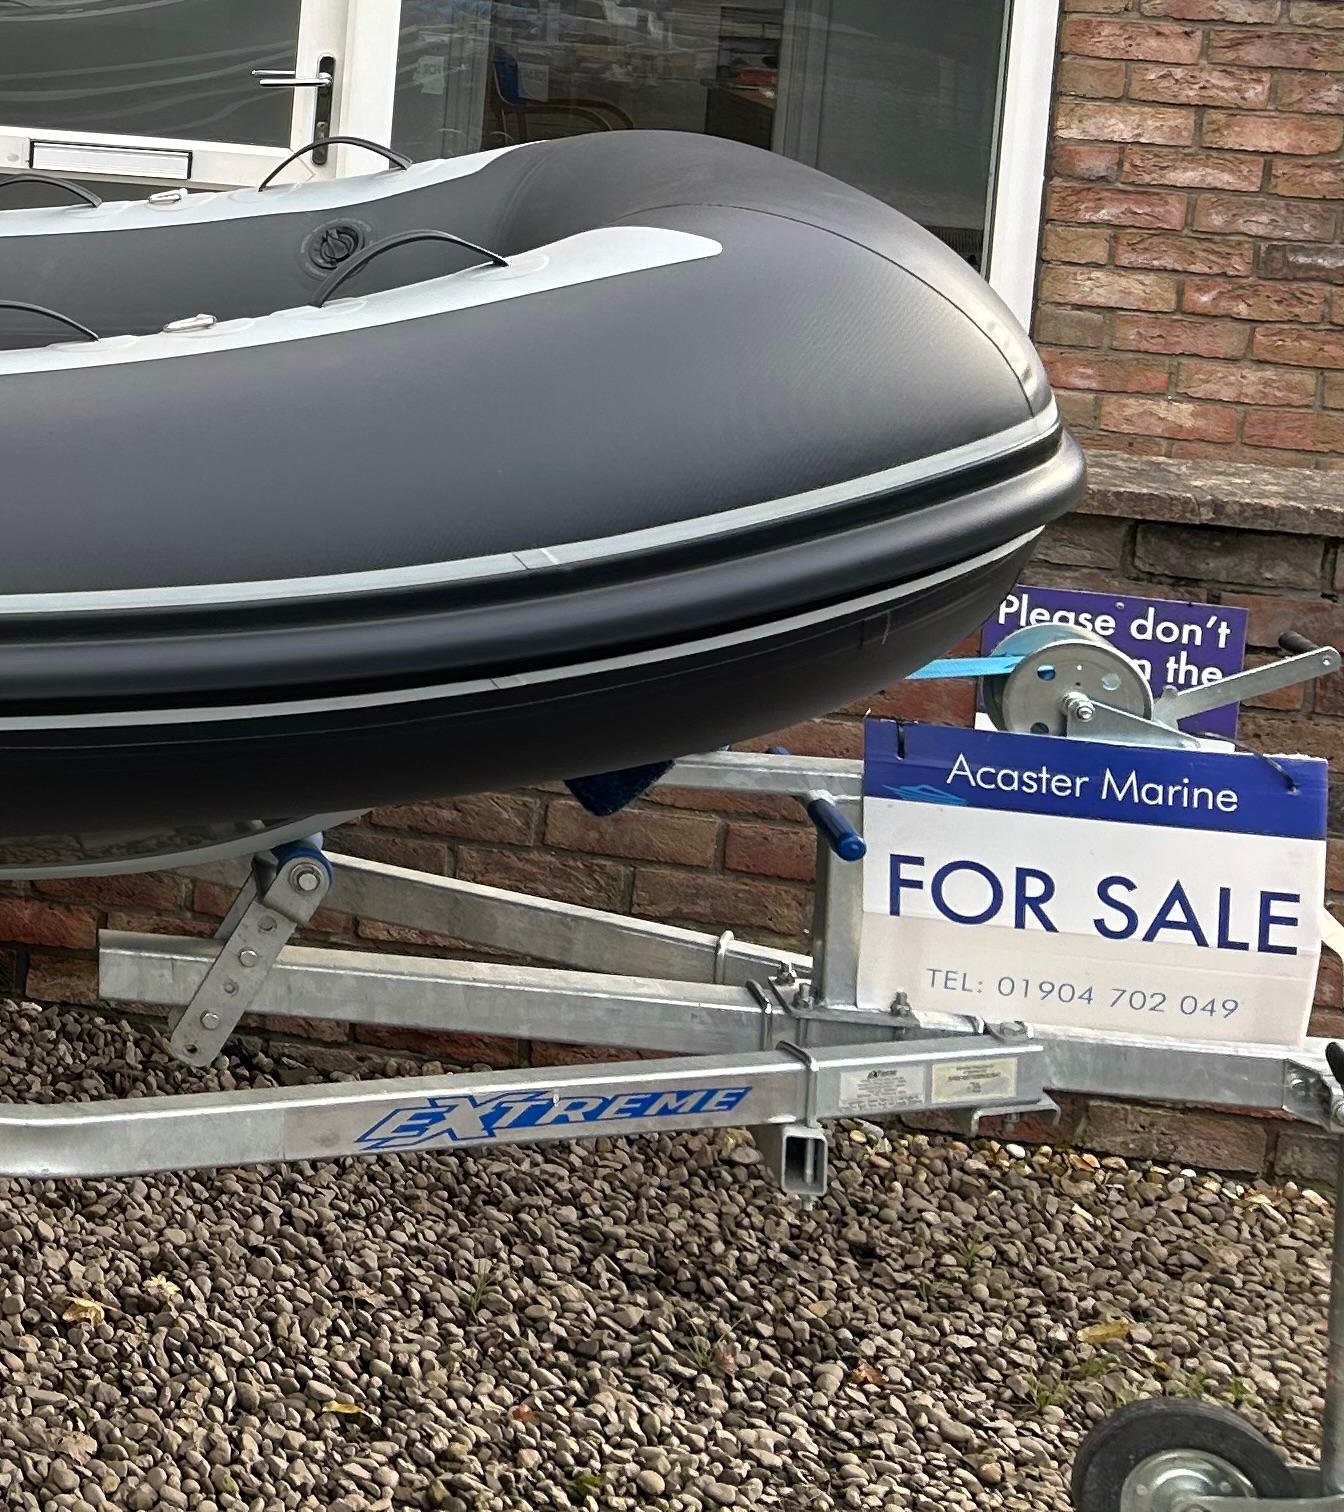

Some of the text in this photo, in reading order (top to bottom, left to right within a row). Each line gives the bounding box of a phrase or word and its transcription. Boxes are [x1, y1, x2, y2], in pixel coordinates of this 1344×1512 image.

[998, 593, 1231, 649] Please don't
[1165, 649, 1223, 687] the
[946, 752, 1239, 812] Acaster Marine
[888, 853, 1301, 956] FOR SALE
[925, 968, 1240, 1020] TEL: 01904 702 049
[354, 1086, 752, 1150] EXTREME
